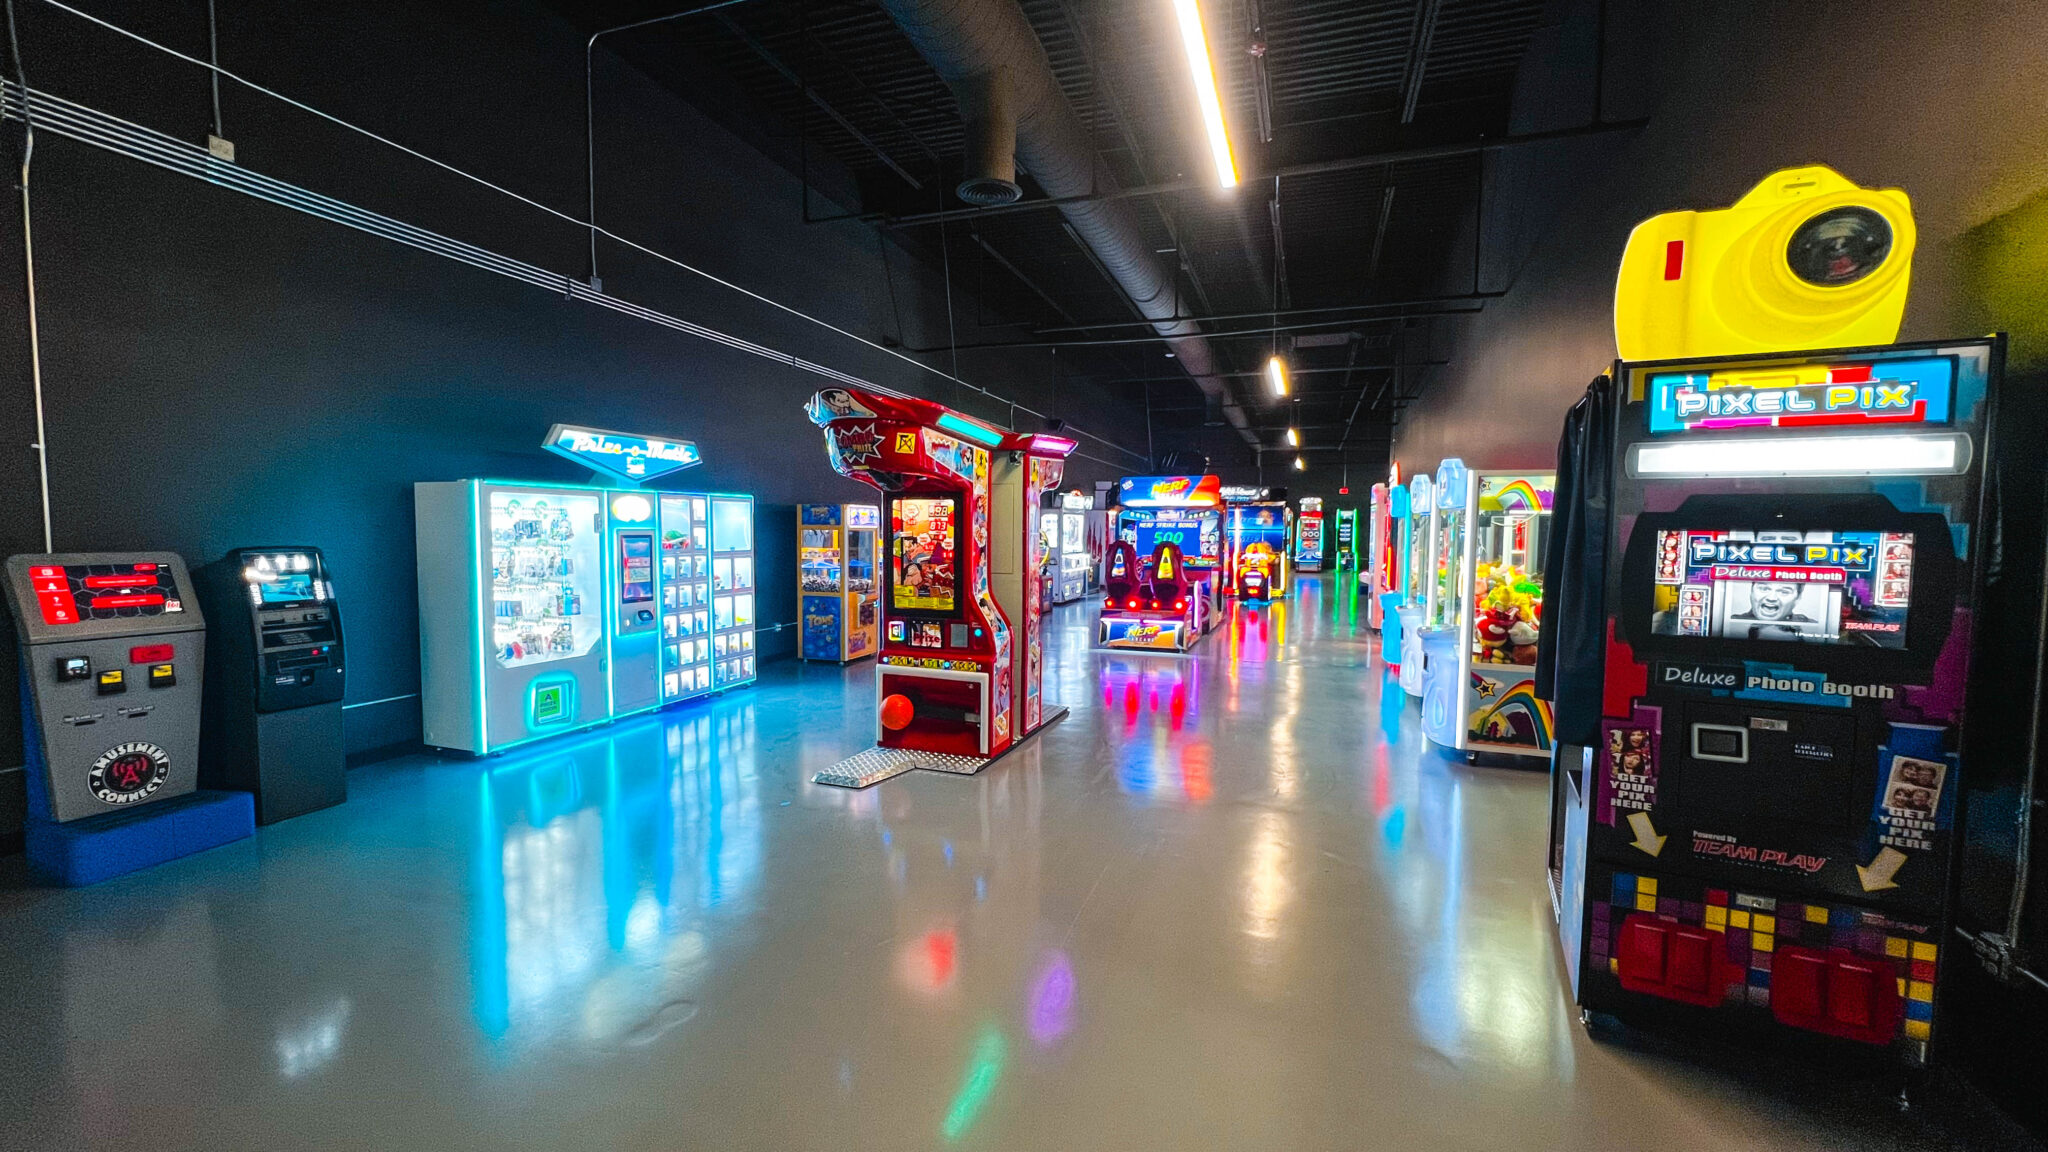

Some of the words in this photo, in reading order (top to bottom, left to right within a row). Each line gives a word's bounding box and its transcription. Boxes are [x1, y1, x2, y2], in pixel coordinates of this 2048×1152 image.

[1677, 391, 1815, 417] PIXEL
[1825, 385, 1911, 411] PIX
[1151, 478, 1189, 495] NERF
[930, 521, 946, 530] 873
[1153, 531, 1184, 544] 500
[1694, 544, 1798, 562] PIXEL
[1805, 545, 1868, 565] PIX
[256, 555, 310, 571] ATM
[1714, 566, 1771, 579] Deluxe
[1775, 571, 1807, 580] Photo
[1809, 572, 1842, 581] Booth
[1128, 625, 1160, 637] NERF
[1845, 622, 1872, 631] TEAM
[1872, 623, 1900, 632] PLAY
[1665, 667, 1736, 686] Deluxe
[1748, 675, 1815, 693] Photo
[1822, 681, 1895, 700] Booth
[91, 743, 169, 777] AMUSEMENT
[1618, 773, 1648, 784] GET
[98, 777, 163, 803] CONNECT
[1610, 780, 1655, 794] YOUR
[1618, 790, 1645, 801] PIX
[1610, 798, 1653, 811] HERE
[1888, 807, 1929, 819] GET
[1879, 815, 1936, 831] YOUR
[1693, 830, 1726, 841] Powered
[1889, 826, 1924, 839] PIX
[1879, 834, 1933, 850] HERE
[1692, 839, 1757, 861] TEAM
[1760, 849, 1827, 872] PLAY
